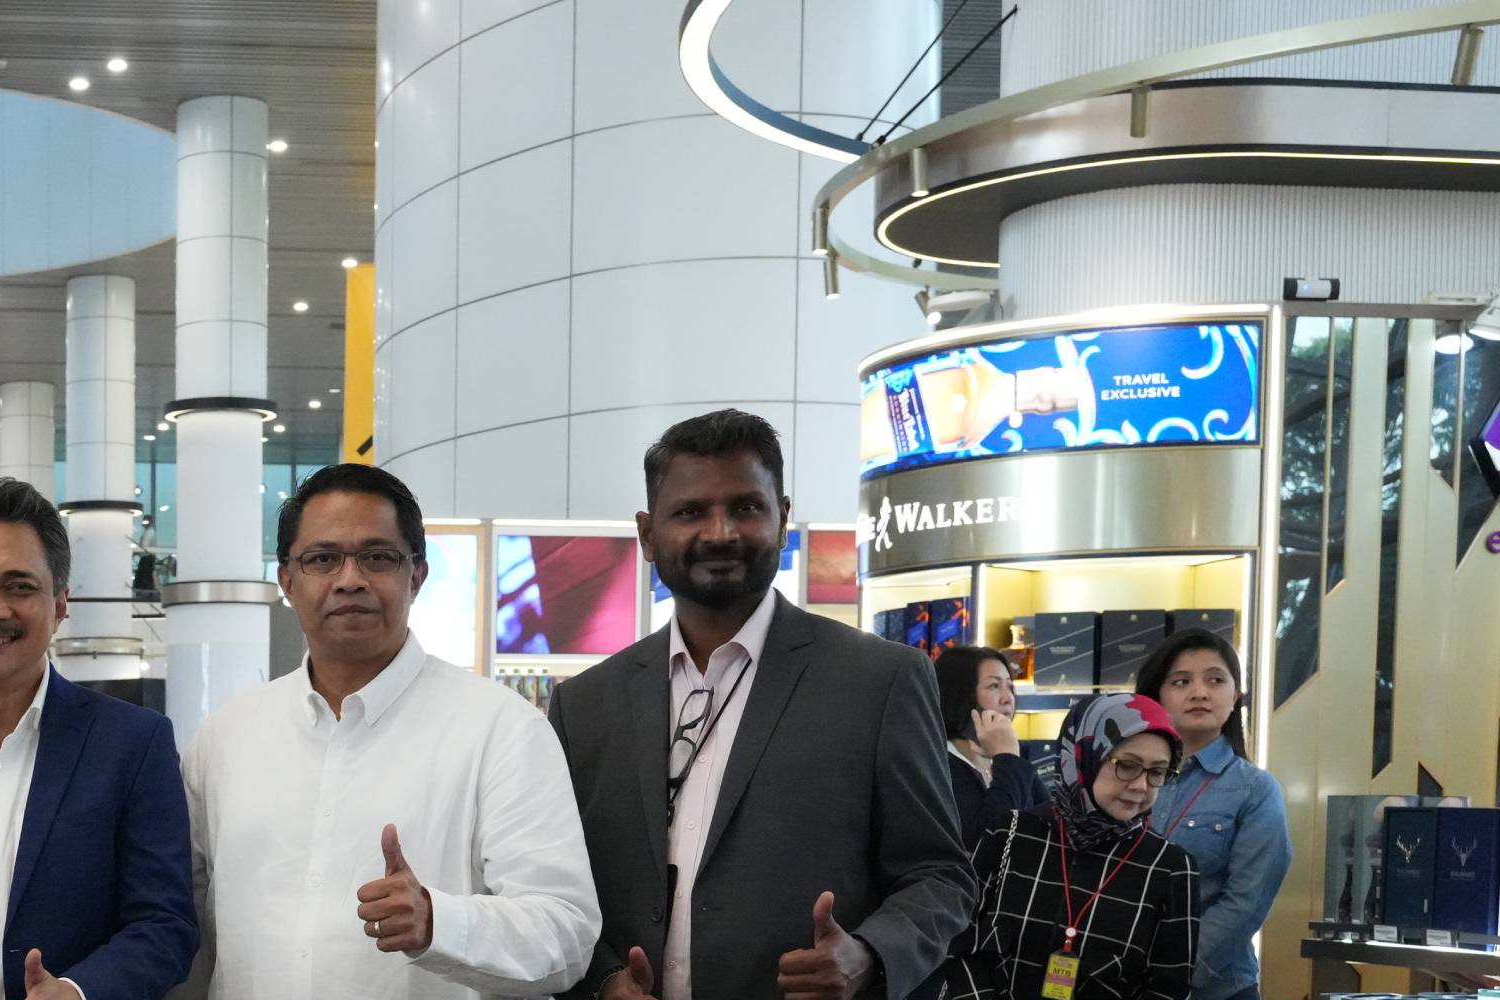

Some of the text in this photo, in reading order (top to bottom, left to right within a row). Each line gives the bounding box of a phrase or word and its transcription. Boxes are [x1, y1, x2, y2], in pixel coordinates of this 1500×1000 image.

[1113, 373, 1169, 386] TRAVEL
[1101, 386, 1181, 401] EXCLUSIVE
[894, 497, 1019, 534] WALKER
